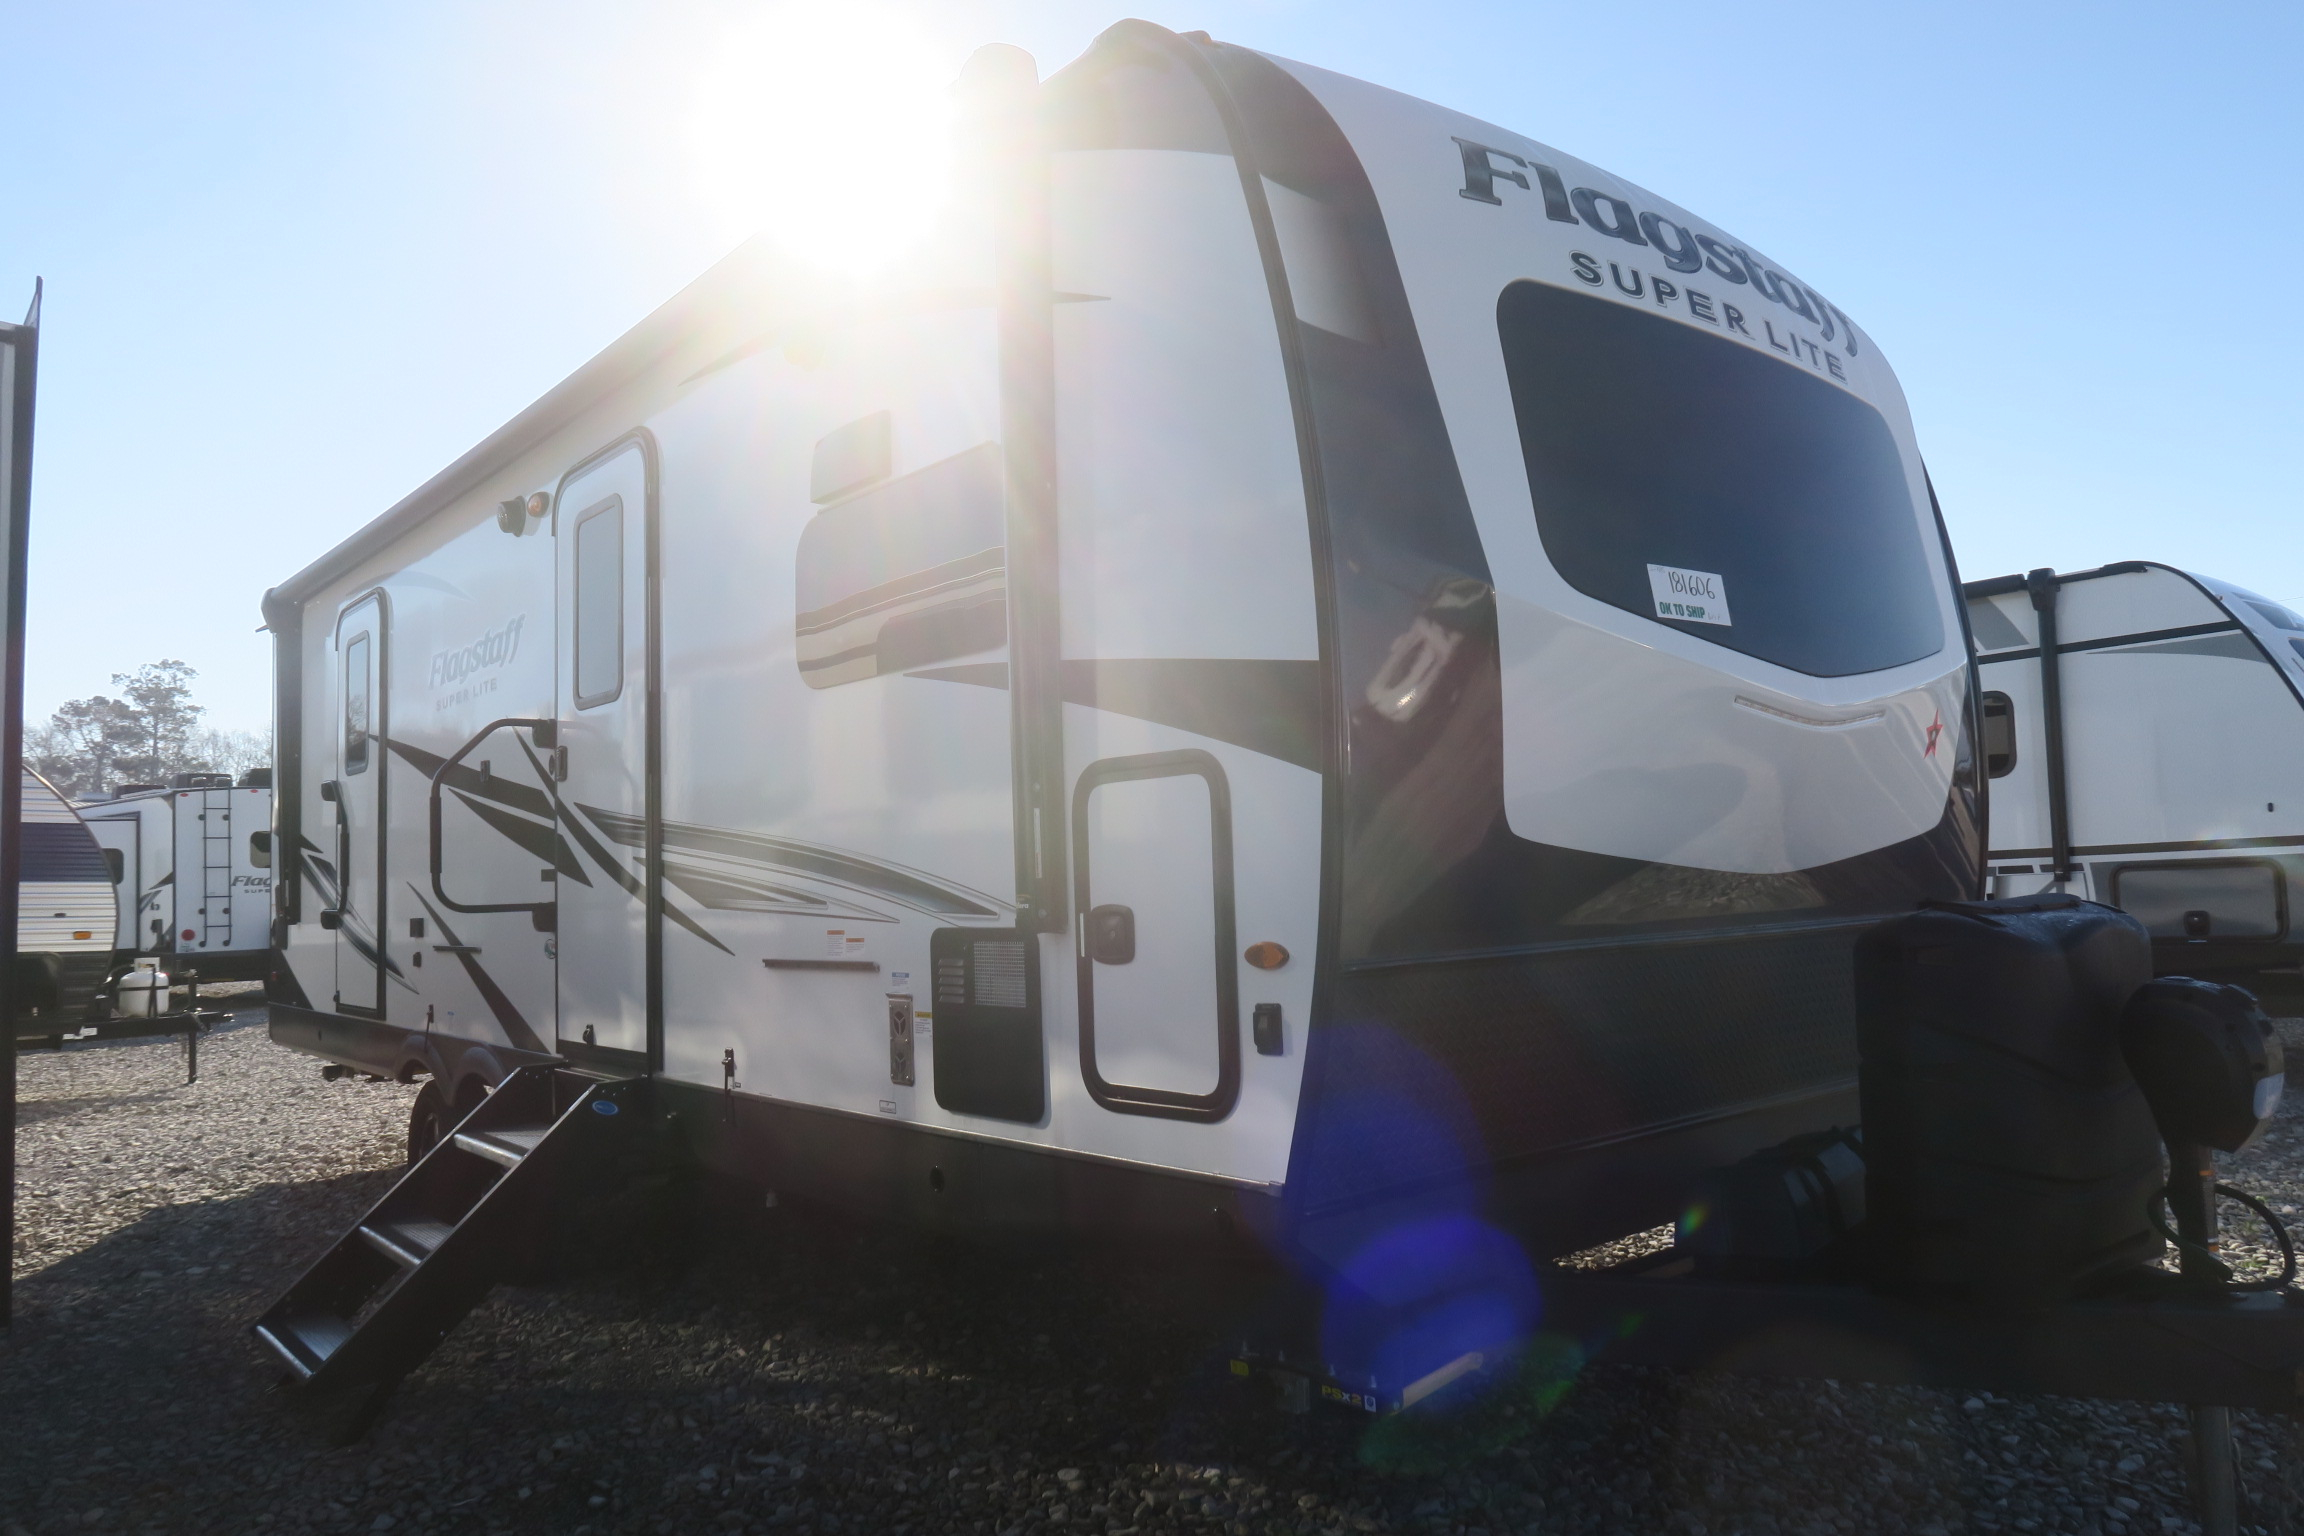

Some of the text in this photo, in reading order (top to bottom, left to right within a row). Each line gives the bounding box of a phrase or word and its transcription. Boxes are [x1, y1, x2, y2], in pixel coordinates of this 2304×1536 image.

[1451, 136, 1859, 358] Flagstaff
[1568, 249, 1848, 385] SUPER LITE
[1659, 602, 1673, 615] OK
[1673, 603, 1685, 617] TO
[1685, 605, 1706, 619] SHIP
[1668, 571, 1716, 600] 181606
[428, 612, 526, 691] Flagstaff
[435, 677, 498, 712] SUPER LITE
